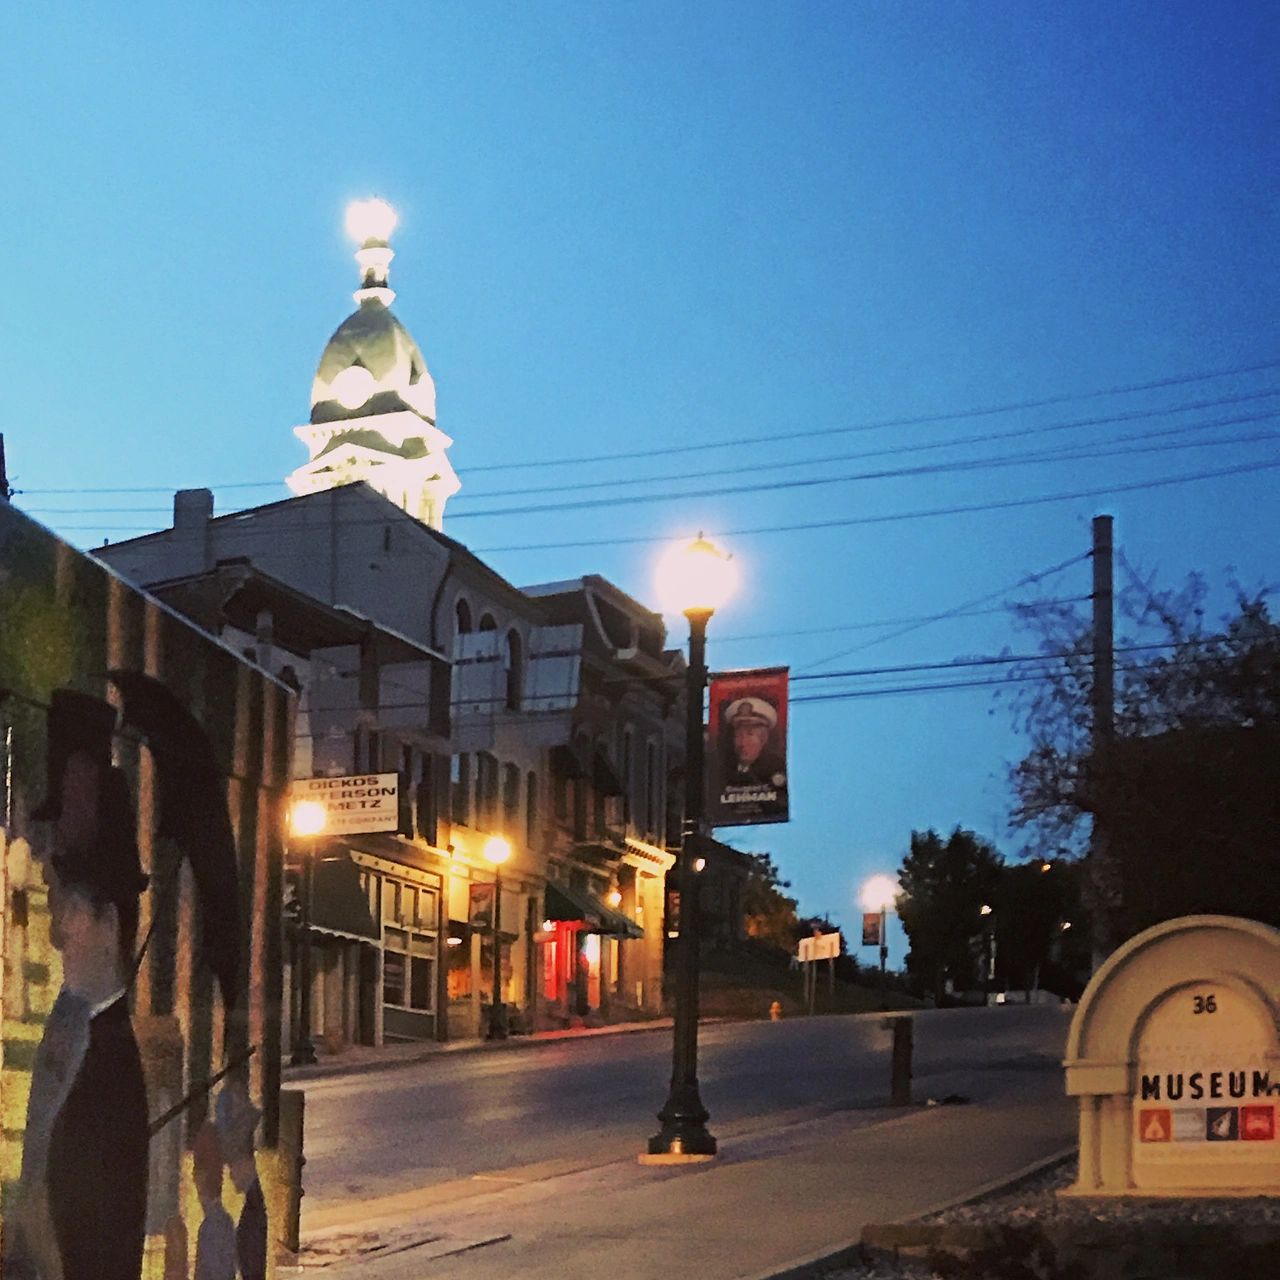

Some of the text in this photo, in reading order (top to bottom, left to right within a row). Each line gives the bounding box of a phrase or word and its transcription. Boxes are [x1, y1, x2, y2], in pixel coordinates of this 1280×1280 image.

[328, 800, 382, 812] METZ
[1192, 995, 1218, 1014] 36
[1141, 1070, 1270, 1101] MUSEUM
